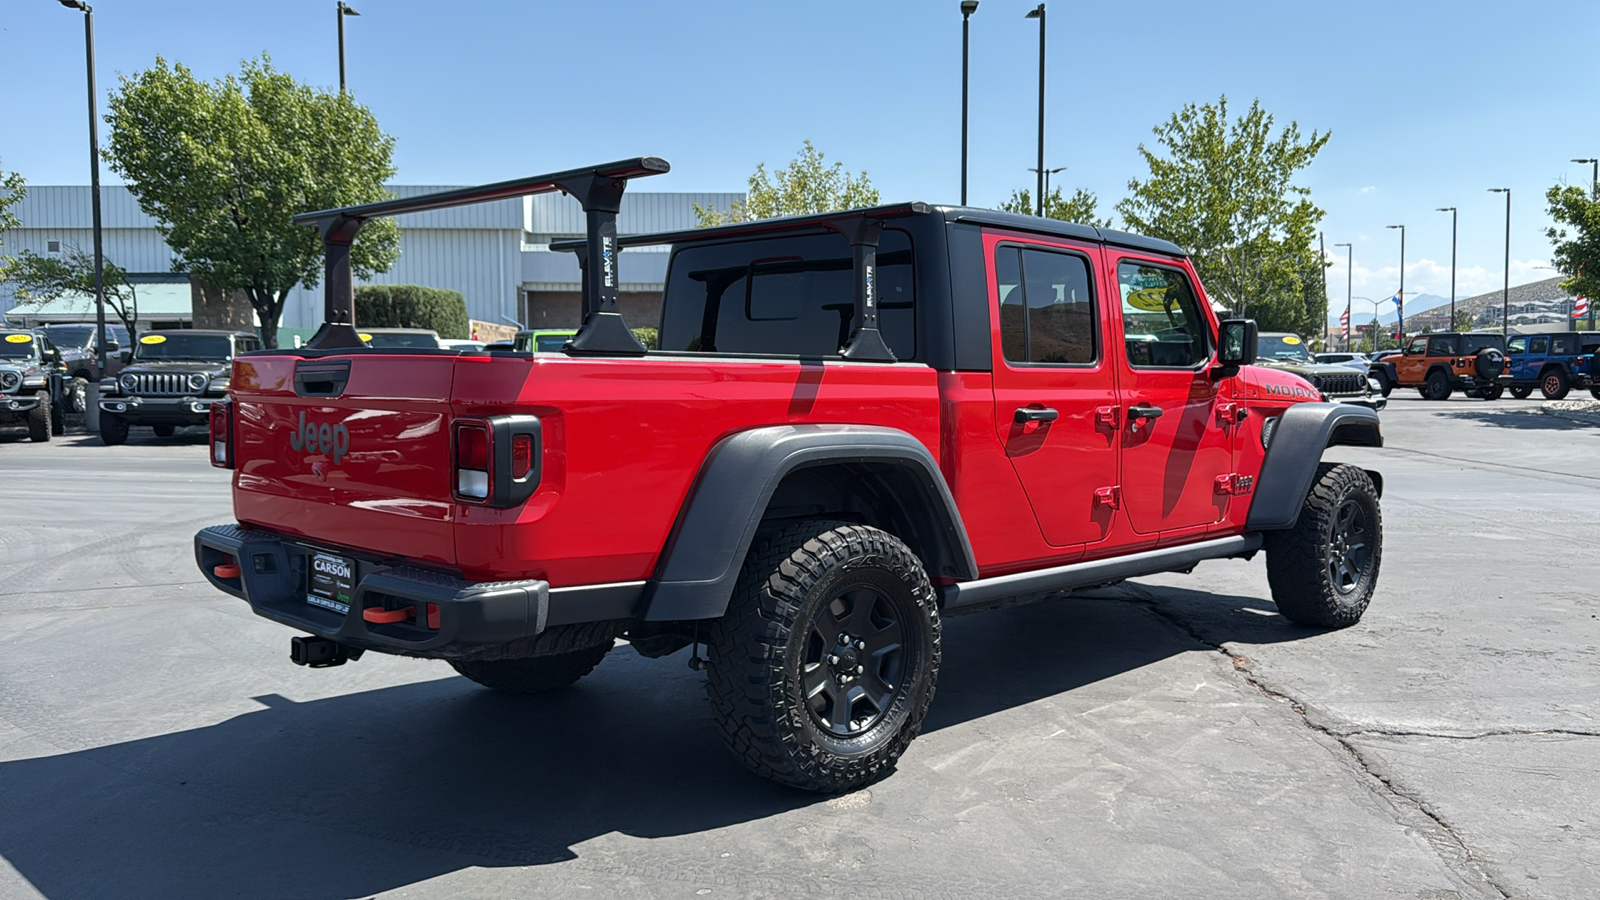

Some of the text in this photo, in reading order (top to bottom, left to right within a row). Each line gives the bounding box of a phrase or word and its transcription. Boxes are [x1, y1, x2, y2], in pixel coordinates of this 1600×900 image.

[602, 236, 611, 287] ELEVATE
[1265, 384, 1319, 399] MOJAVE
[290, 410, 350, 465] Jeep
[313, 560, 351, 579] CARSON
